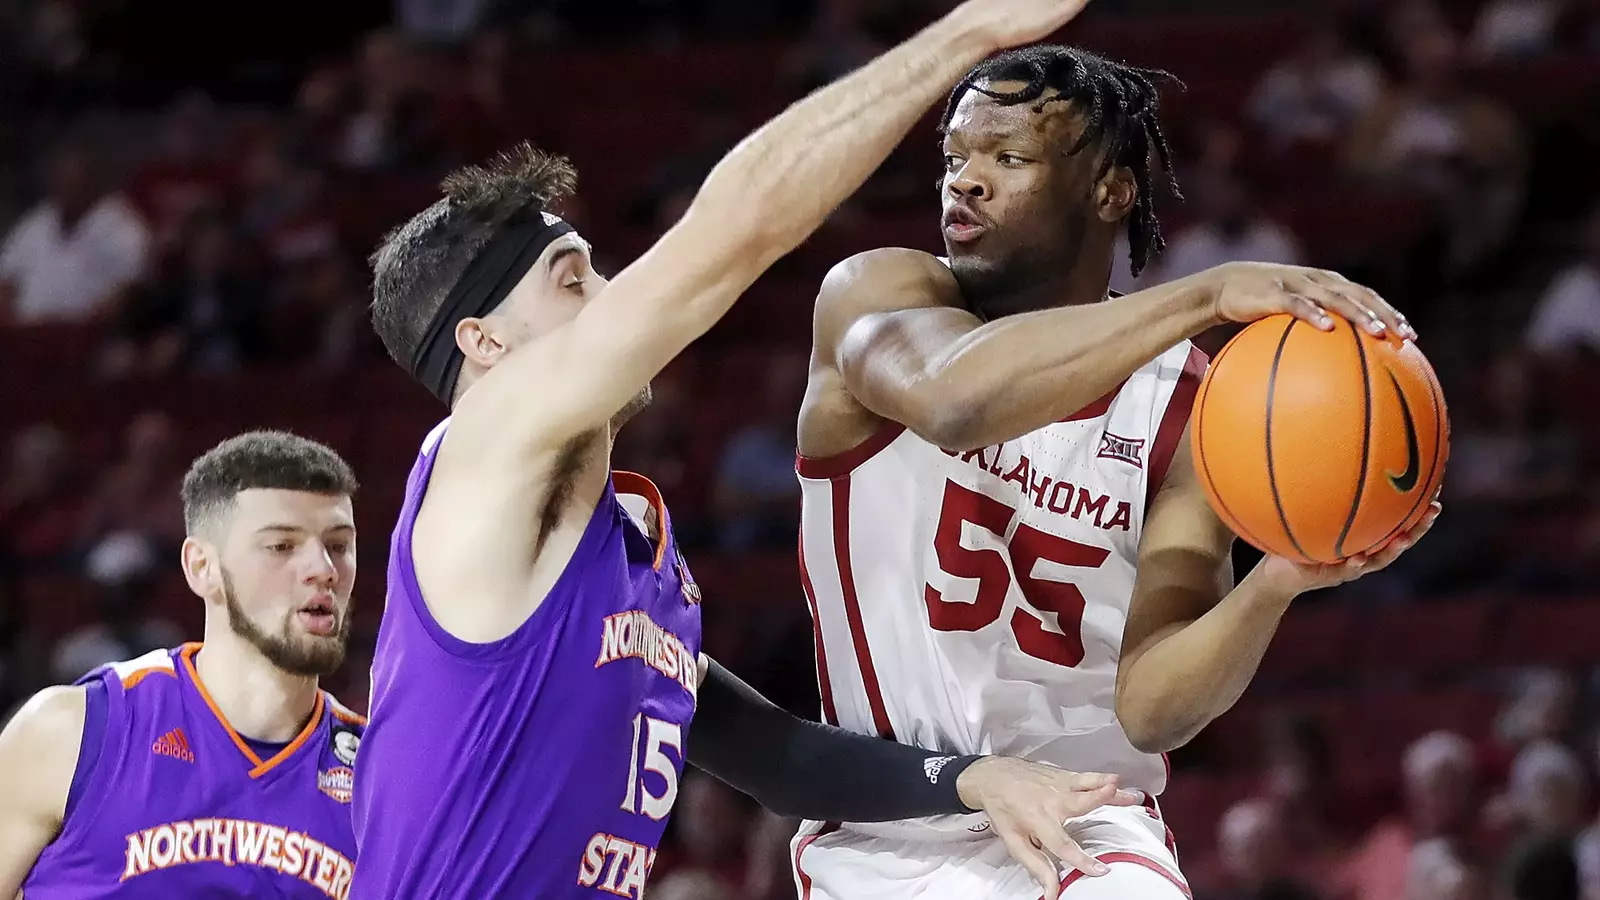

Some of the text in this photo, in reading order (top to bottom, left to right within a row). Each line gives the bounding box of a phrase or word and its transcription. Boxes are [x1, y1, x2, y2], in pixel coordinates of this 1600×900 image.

[925, 477, 1112, 669] 55
[152, 741, 195, 764] adidas
[620, 712, 683, 821] 15
